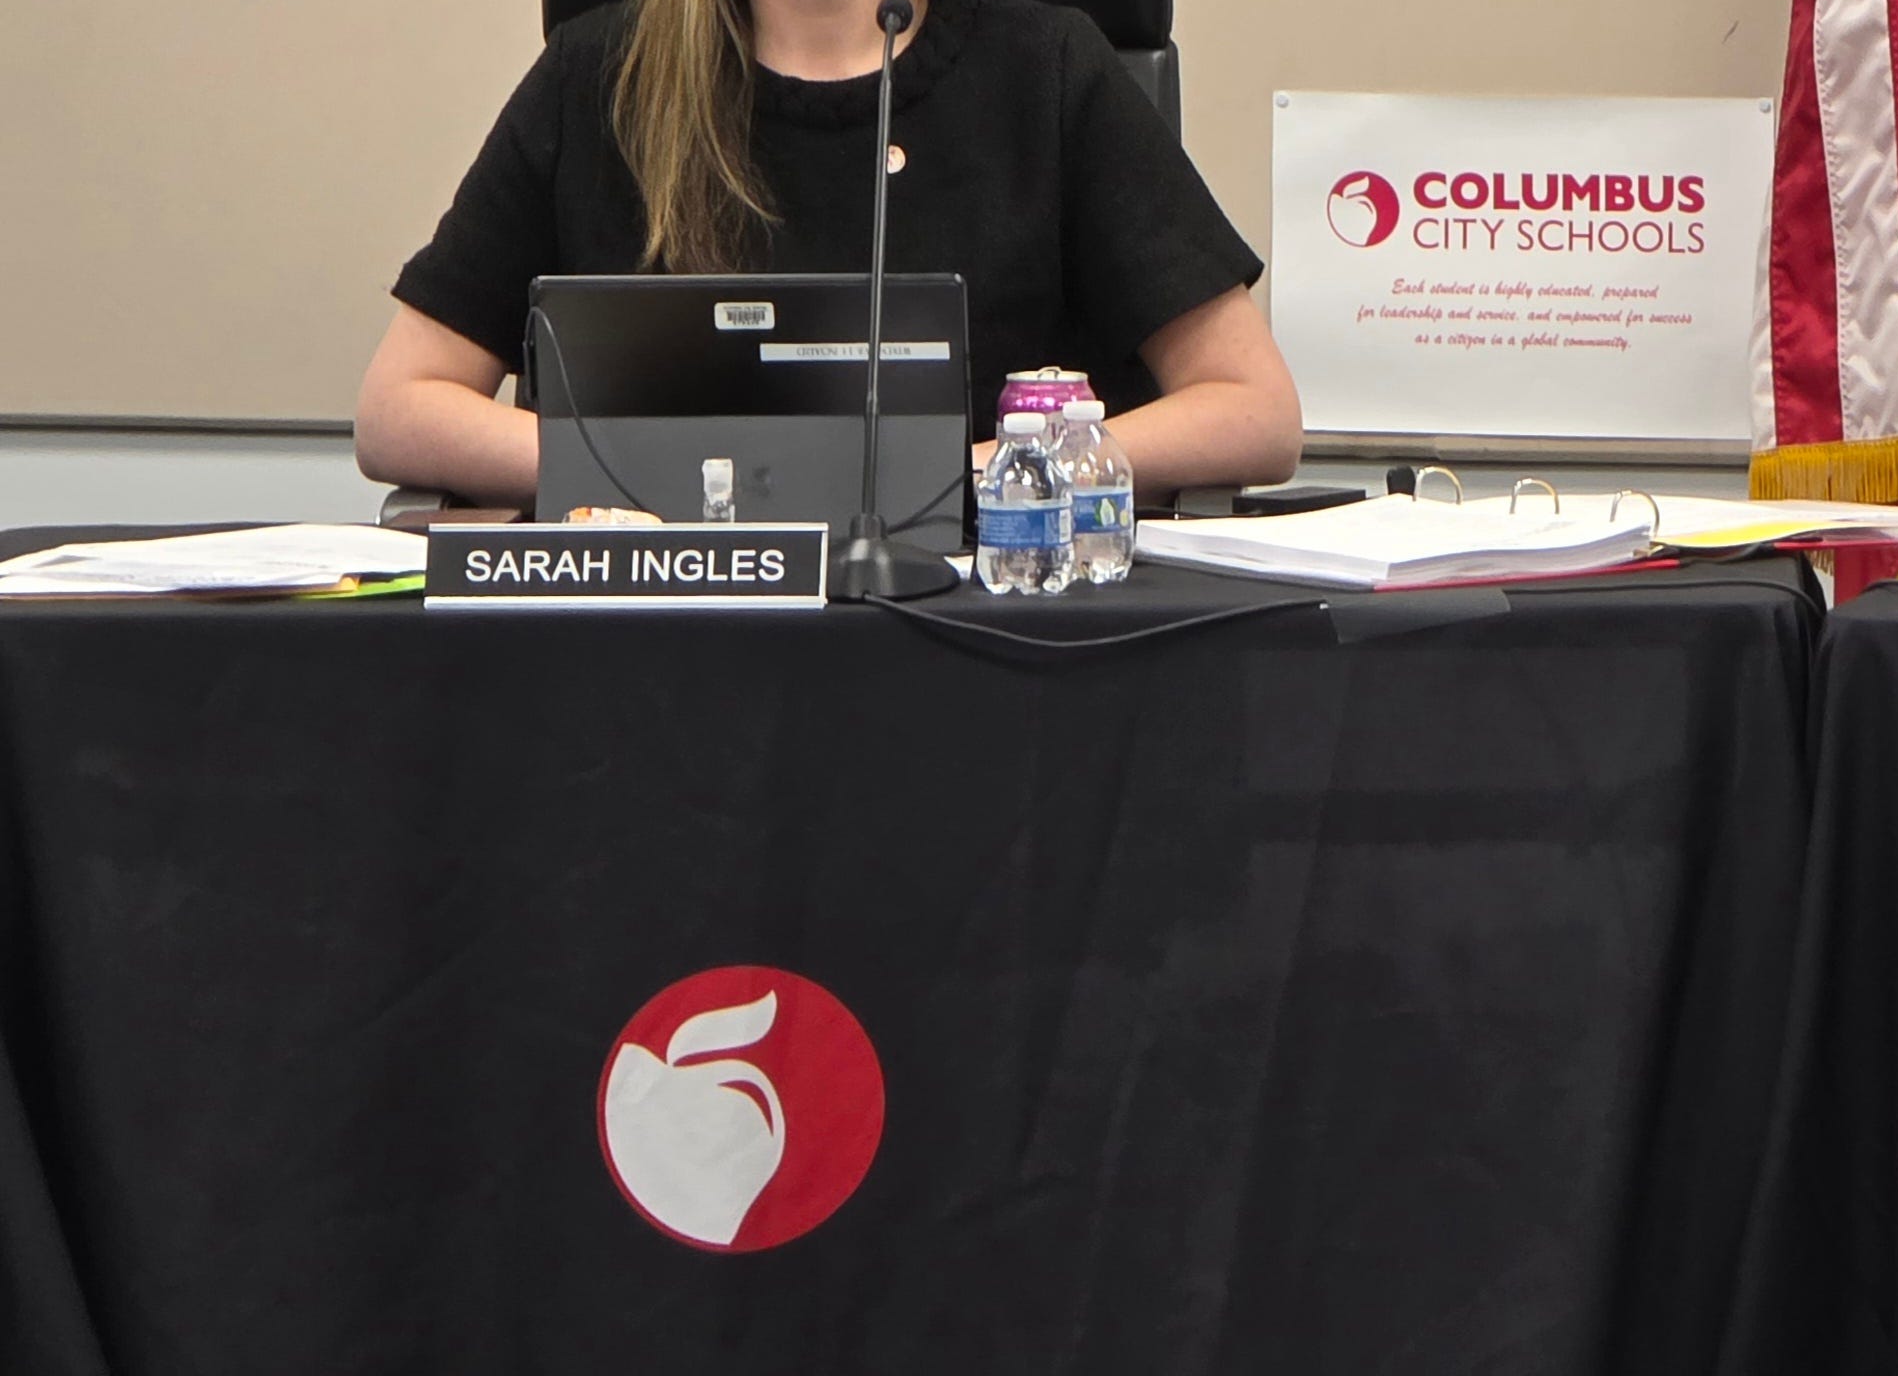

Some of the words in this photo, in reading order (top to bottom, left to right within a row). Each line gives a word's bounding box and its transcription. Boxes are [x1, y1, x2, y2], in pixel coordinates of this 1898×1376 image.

[1412, 171, 1706, 215] COLUMBUS
[1412, 218, 1505, 251] CITY
[1516, 220, 1706, 254] SCHOOLS
[1392, 278, 1425, 295] Each
[1430, 281, 1475, 295] student
[1479, 282, 1490, 295] is
[1494, 280, 1533, 301] highly
[1602, 284, 1660, 301] prepared
[1356, 304, 1375, 323] for
[1380, 304, 1443, 322] leadership
[1448, 305, 1474, 320] and
[1527, 308, 1552, 321] and
[1556, 309, 1623, 325] empowered
[1626, 309, 1644, 328] for
[1649, 312, 1692, 324] success
[1415, 334, 1429, 344] as
[1434, 334, 1442, 344] a
[1448, 332, 1486, 350] citizen
[1491, 333, 1503, 345] in
[1508, 335, 1516, 346] a
[1521, 332, 1559, 350] global
[465, 549, 610, 583] SARAH
[631, 549, 785, 583] INGLES
